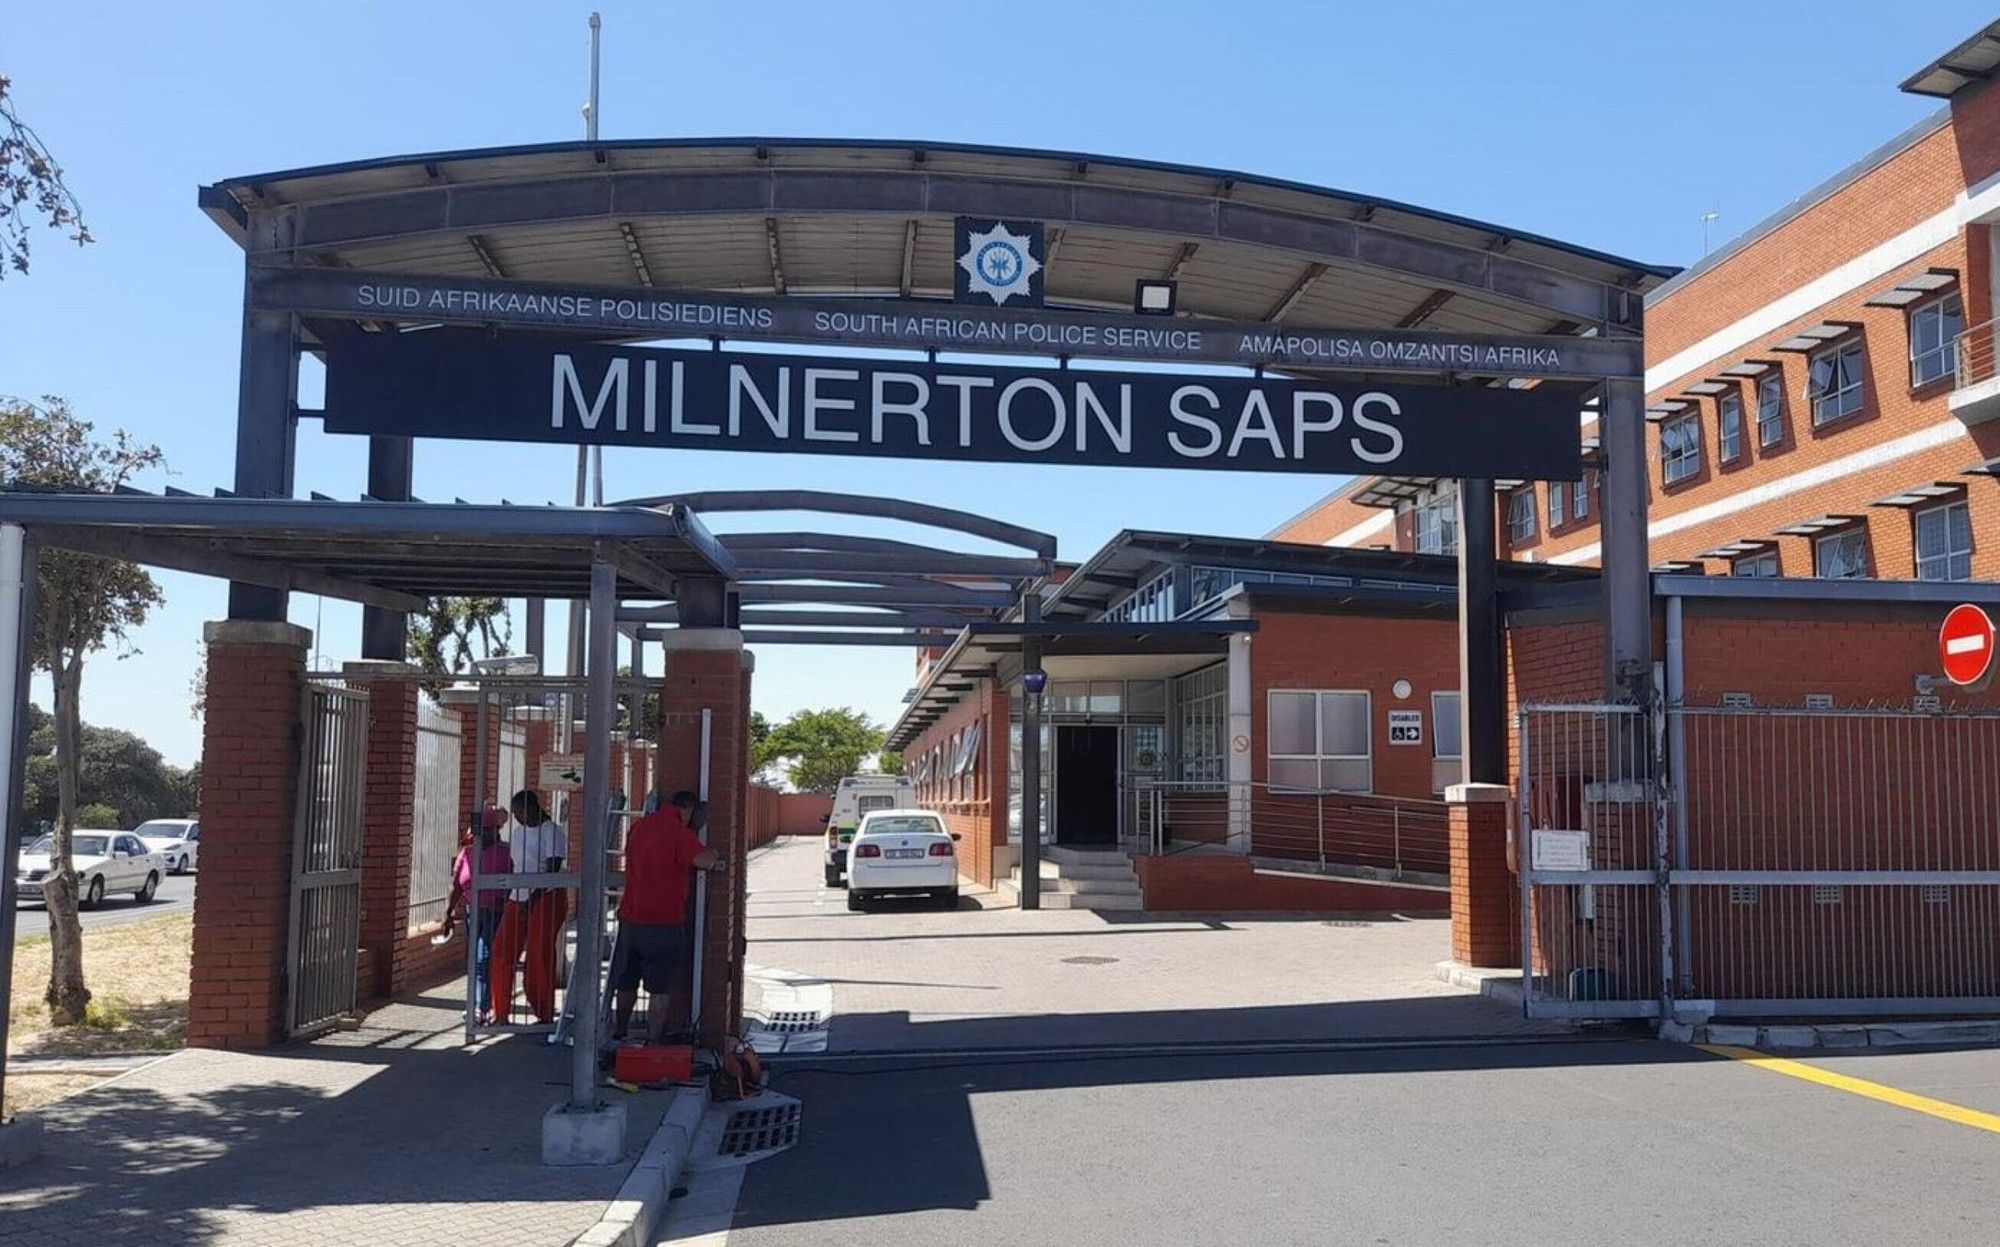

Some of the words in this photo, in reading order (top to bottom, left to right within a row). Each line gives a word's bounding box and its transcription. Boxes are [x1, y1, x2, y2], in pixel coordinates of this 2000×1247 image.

[358, 285, 421, 308] SUID
[428, 290, 592, 317] AFRIKAANSE
[600, 299, 773, 328] POLISIEDIENS
[814, 312, 897, 334] SOUTH
[905, 317, 1007, 341] AFRICAN
[1014, 322, 1097, 346] POLICE
[1103, 328, 1201, 350] SERVICE
[1239, 334, 1363, 358] AMAPOLISA
[1369, 340, 1479, 363] OMZANTSI
[1485, 346, 1560, 367] AFRIKA
[551, 353, 1132, 454] MILNERTON
[1167, 385, 1404, 464] SAPS
